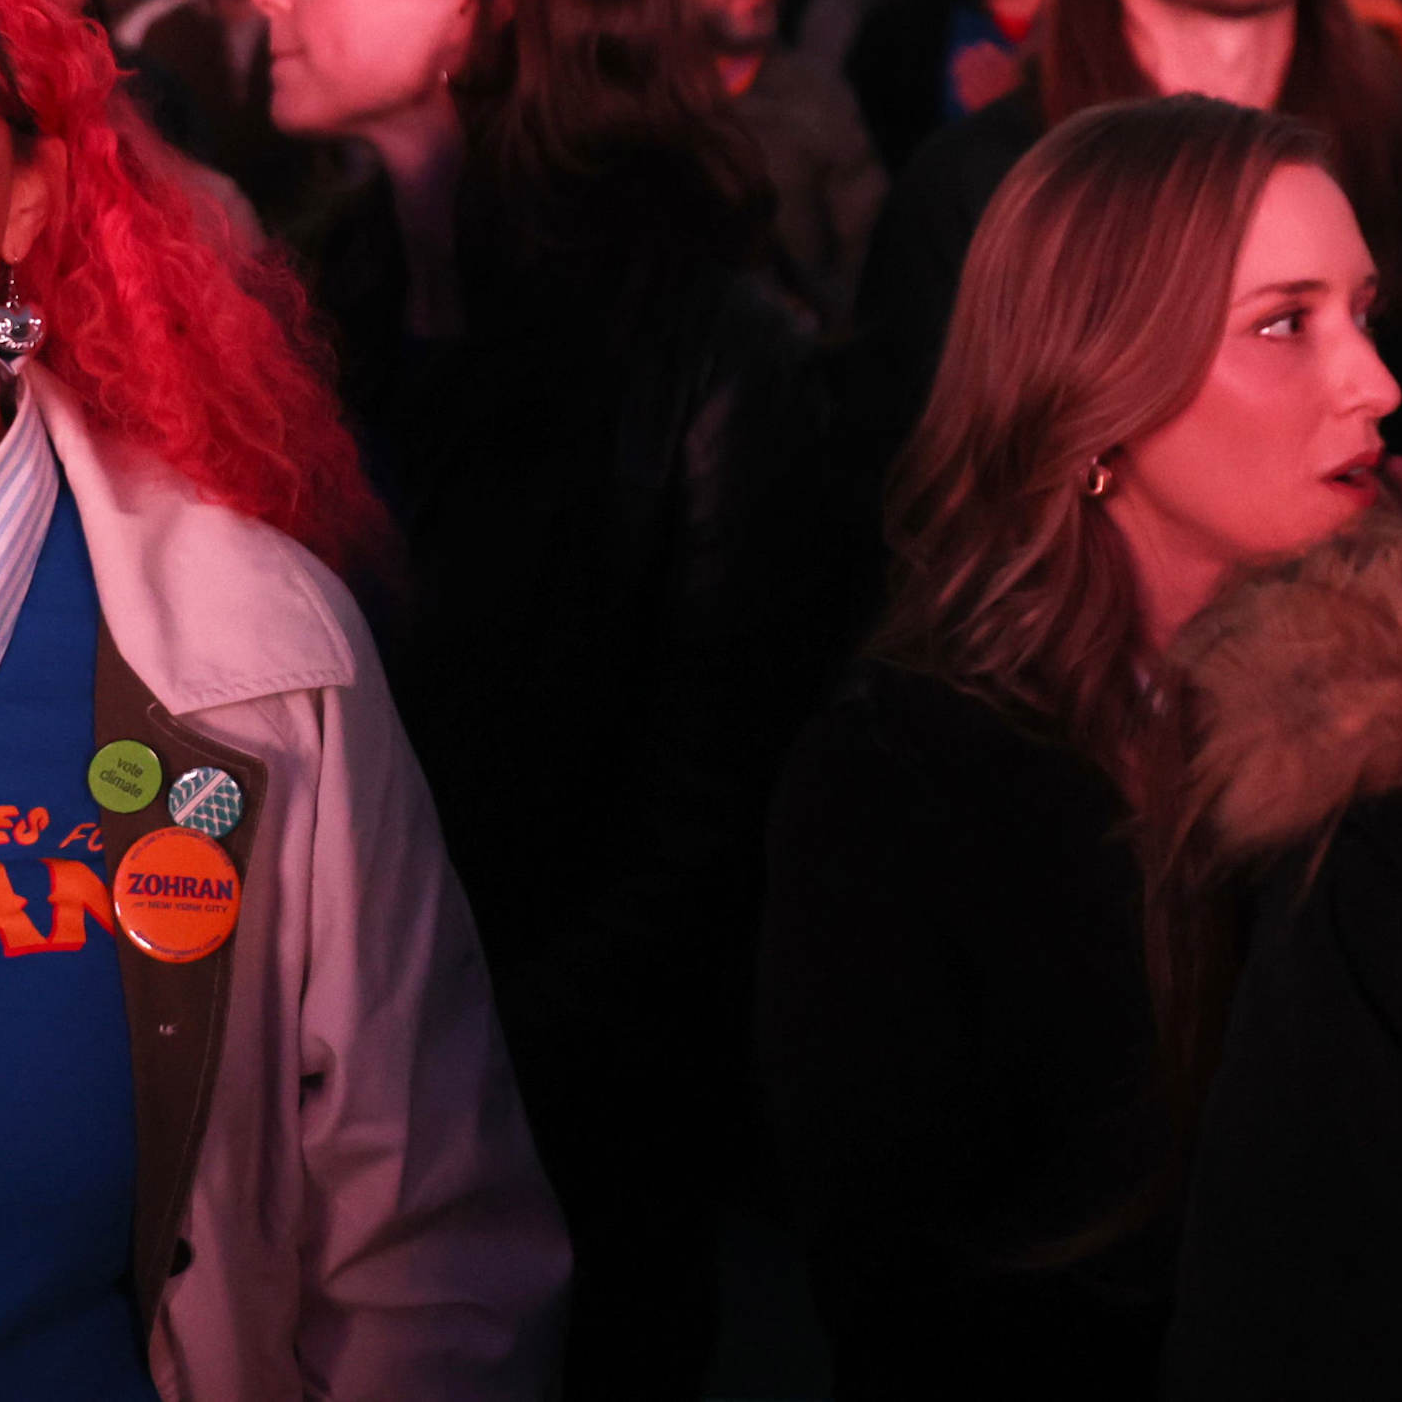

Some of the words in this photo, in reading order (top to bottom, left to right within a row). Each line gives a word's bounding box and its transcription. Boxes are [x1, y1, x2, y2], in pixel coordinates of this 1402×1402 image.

[117, 757, 143, 778] vote
[100, 769, 143, 798] climate
[126, 872, 234, 900] ZOHRAN
